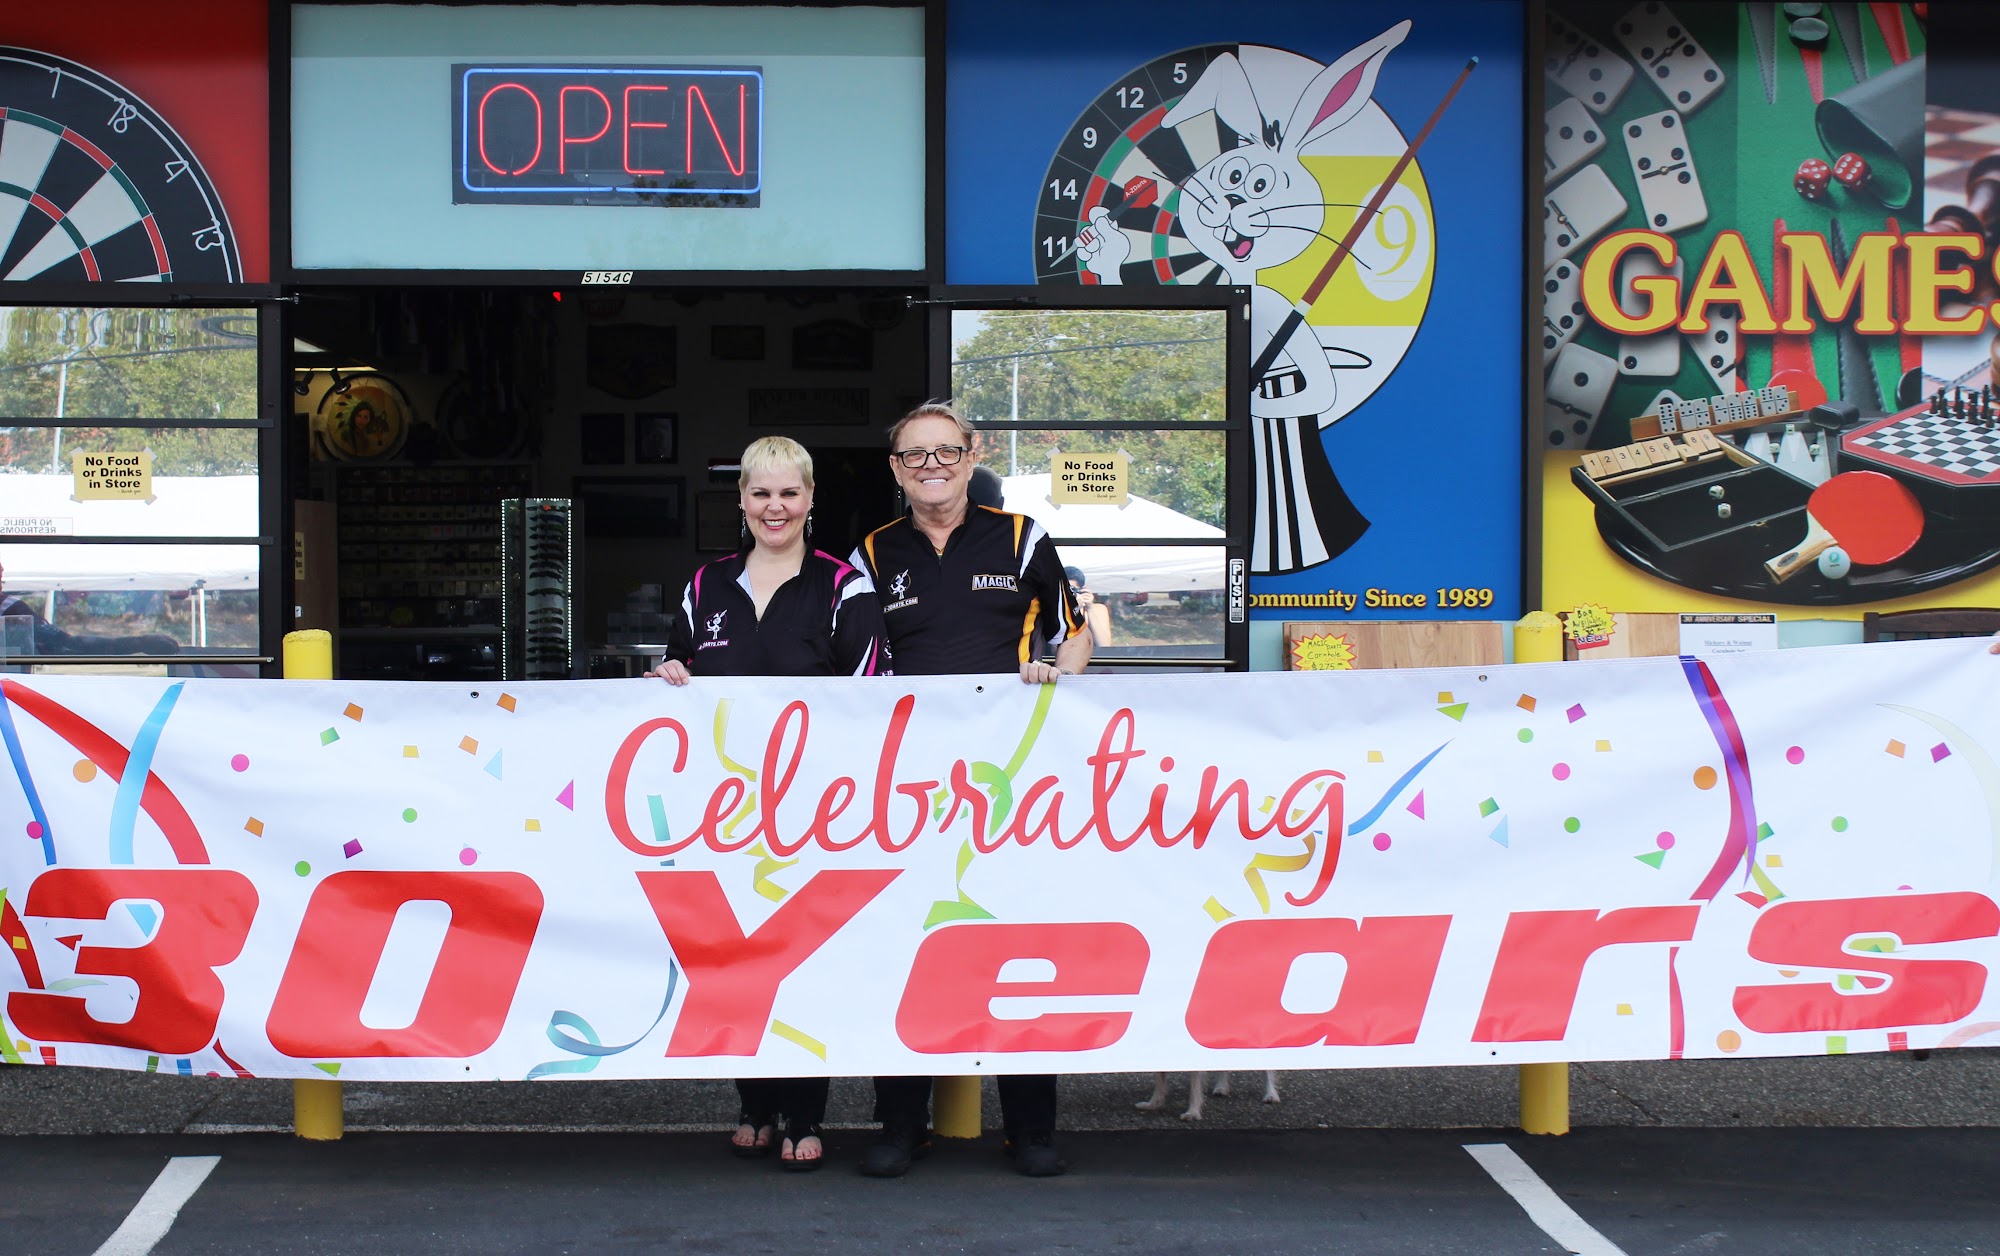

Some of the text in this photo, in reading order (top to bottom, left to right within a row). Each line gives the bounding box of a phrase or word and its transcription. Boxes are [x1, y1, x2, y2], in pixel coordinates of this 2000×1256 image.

[1172, 62, 1188, 84] 5
[1115, 86, 1145, 109] 12
[106, 97, 137, 134] 18
[479, 83, 744, 175] OPEN
[1082, 127, 1098, 149] 9
[165, 159, 189, 184] 4
[1049, 178, 1079, 200] 14
[192, 217, 225, 251] 13
[1374, 204, 1417, 276] 9
[1042, 236, 1067, 258] 11
[584, 272, 631, 283] 5154C
[1580, 228, 2000, 335] GAME
[85, 456, 139, 466] No Food
[1064, 461, 1114, 470] No Food
[89, 479, 141, 488] in Store
[100, 468, 142, 477] Drinks
[1078, 472, 1116, 481] Drinks
[1067, 483, 1114, 492] in Store
[973, 576, 1016, 590] MAGIC
[1232, 564, 1242, 607] PUSH
[1249, 588, 1494, 611] ommunity Since 1989
[1307, 650, 1341, 660] Cornhole
[605, 694, 1346, 908] Celebrating
[6, 868, 2000, 1058] 30 Years
